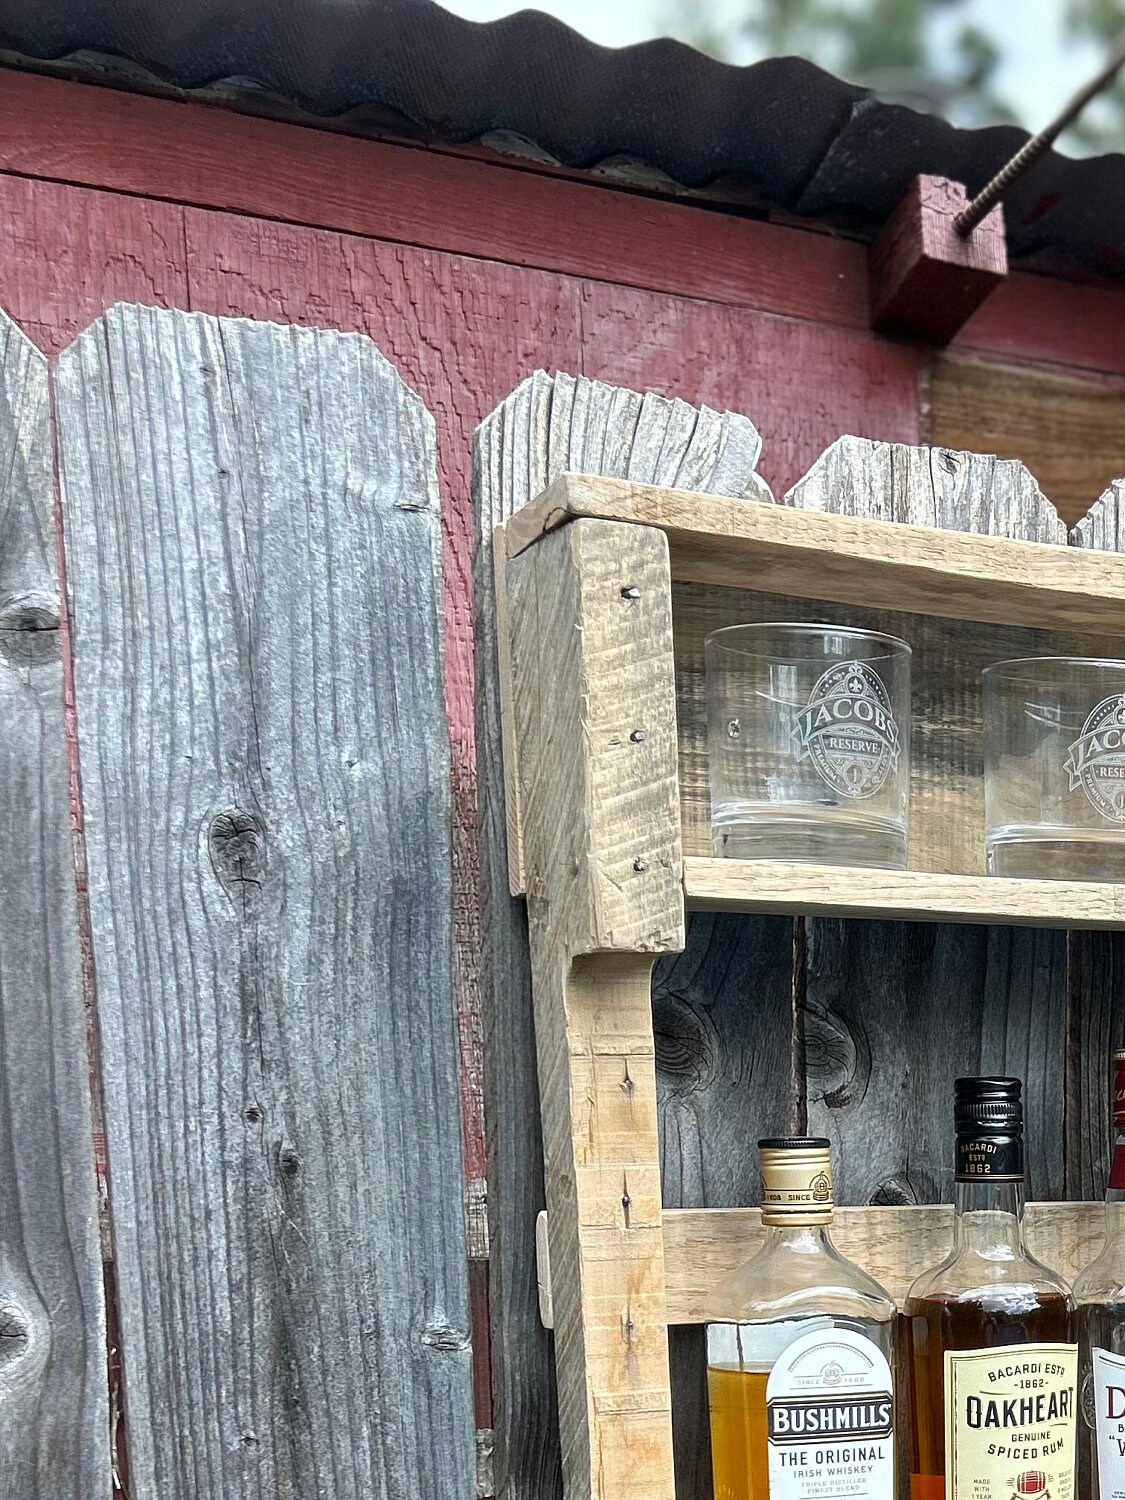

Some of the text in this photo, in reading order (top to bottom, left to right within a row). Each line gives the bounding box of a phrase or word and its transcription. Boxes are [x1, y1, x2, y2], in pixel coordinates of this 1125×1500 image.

[804, 699, 895, 743] JACOBS
[830, 737, 879, 753] RESERVE
[1085, 774, 1106, 807] PREMIUM
[960, 1143, 997, 1154] BACARDI
[965, 1164, 991, 1173] 1862
[988, 1363, 1042, 1382] BACARDI
[773, 1403, 892, 1433] BUSHMILLS
[966, 1387, 1074, 1429] OAKHEART
[1011, 1431, 1051, 1442] GENUINE
[779, 1446, 886, 1467] THE ORIGINAL
[988, 1437, 1064, 1459] SPICED RUM
[793, 1465, 874, 1479] IRISH WHISKEY
